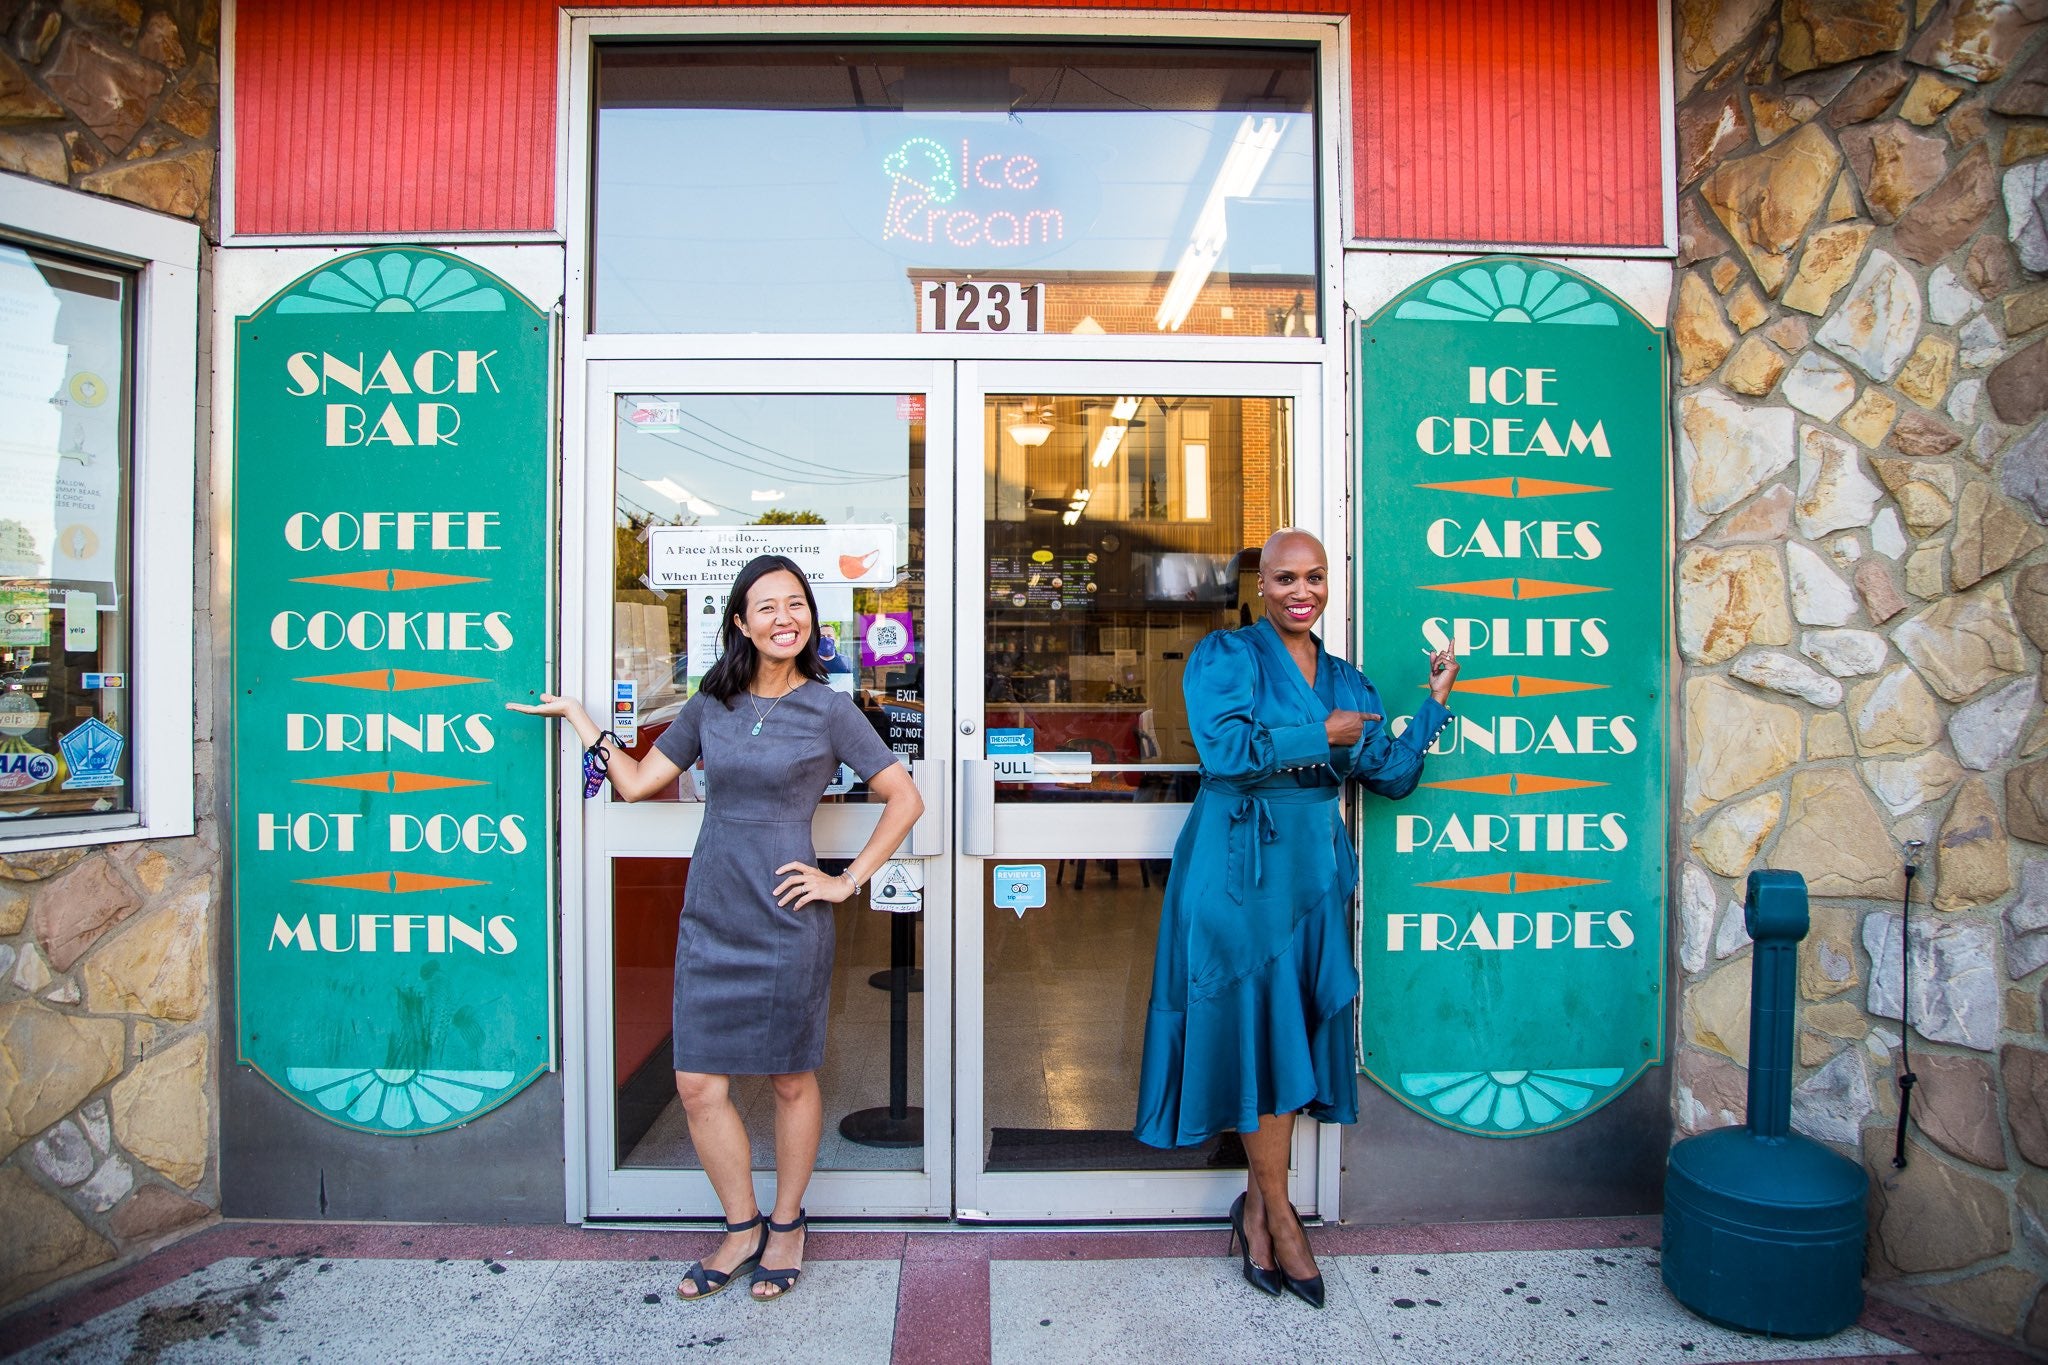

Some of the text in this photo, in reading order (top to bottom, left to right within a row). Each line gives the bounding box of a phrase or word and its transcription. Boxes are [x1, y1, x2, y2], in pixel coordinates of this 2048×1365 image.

[961, 138, 1039, 190] Ice
[929, 284, 1038, 332] 1231
[287, 350, 500, 396] SNACK
[1470, 367, 1557, 405] ICE
[326, 402, 461, 446] BAR
[1417, 417, 1611, 458] CREAM
[285, 511, 501, 552] COFFEE
[666, 544, 820, 555] A Face Mask or Covering
[1427, 518, 1602, 559] CAKES
[661, 572, 697, 581] When
[804, 572, 825, 580] ore
[707, 558, 717, 567] Is
[69, 626, 86, 634] yelp
[270, 611, 513, 652] COOKIES
[1421, 617, 1609, 660] SPLITS
[896, 689, 918, 702] EXIT
[287, 713, 495, 754] DRINKS
[889, 728, 922, 738] DO NOT
[891, 712, 922, 723] PLEASE
[892, 743, 919, 753] ENTER
[258, 812, 527, 855] HOT DOGS
[1397, 812, 1628, 853] PARTIES
[997, 871, 1029, 879] REVIEW
[268, 913, 518, 955] MUFFINS
[1387, 910, 1635, 951] FRAPPES
